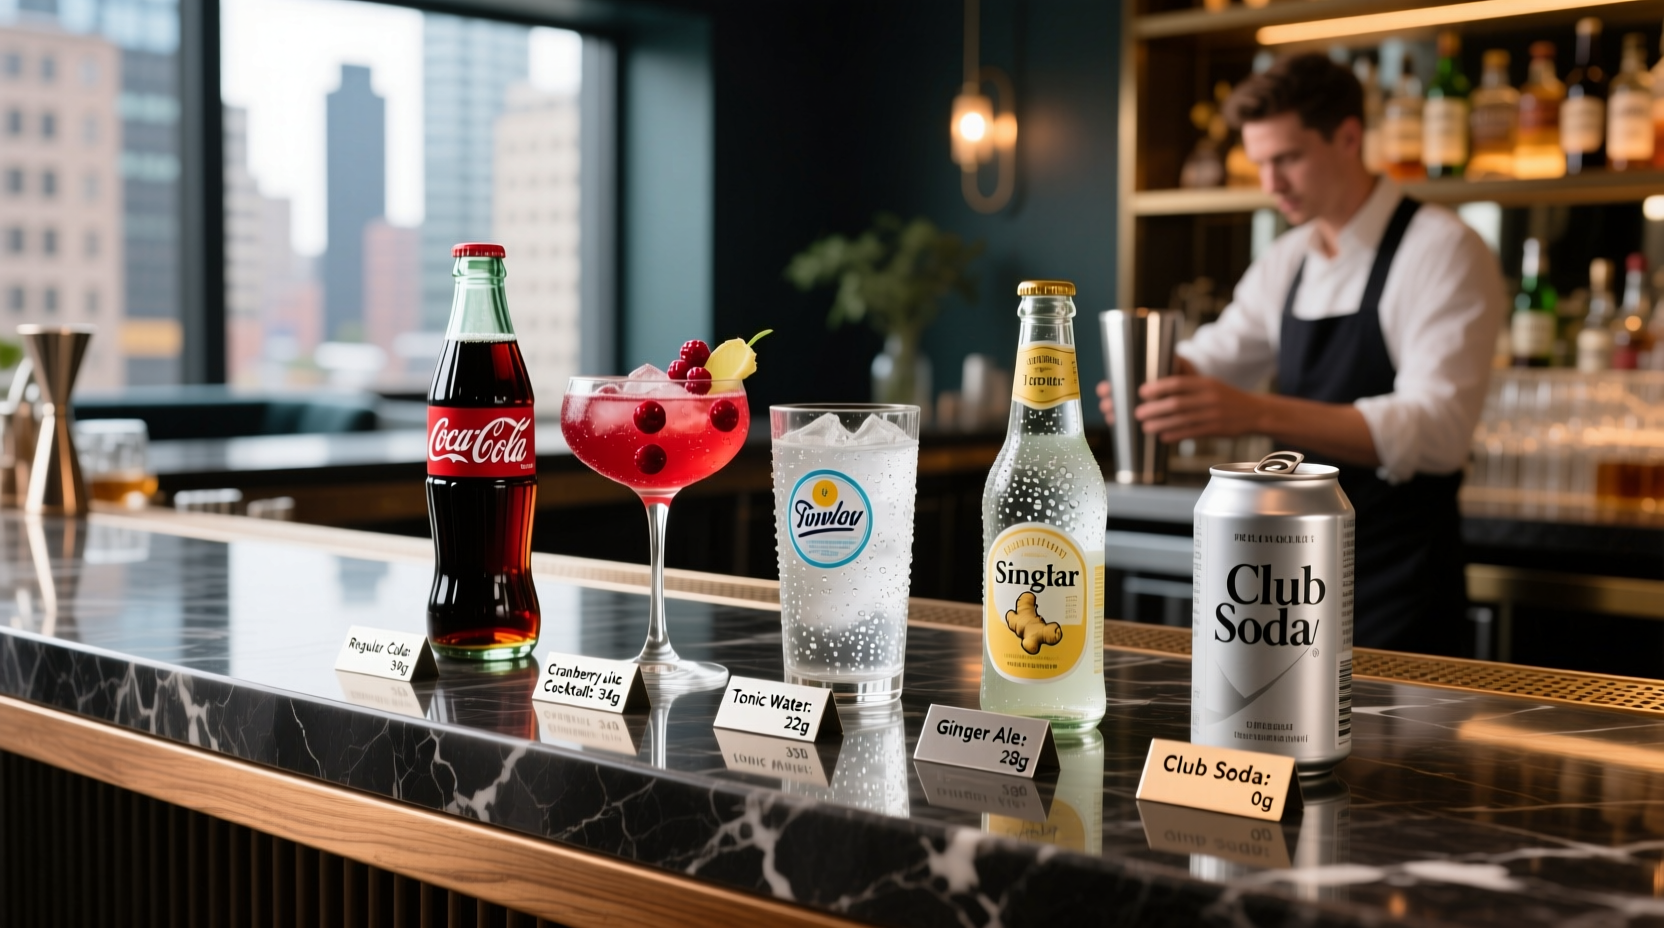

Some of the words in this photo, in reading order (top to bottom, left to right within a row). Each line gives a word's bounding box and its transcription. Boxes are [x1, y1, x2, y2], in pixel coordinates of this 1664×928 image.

[428, 416, 531, 464] Coca-Cola
[1226, 563, 1326, 606] Club
[548, 663, 602, 686] Cranberry
[732, 688, 766, 708] Tonic
[769, 694, 812, 714] Water:
[783, 716, 811, 736] 22g
[936, 718, 990, 744] Ginger
[992, 725, 1028, 747] Ale:
[999, 750, 1030, 773] 28g
[1163, 754, 1207, 776] Club
[1213, 761, 1272, 786] Soda:
[1251, 790, 1275, 812] 0g
